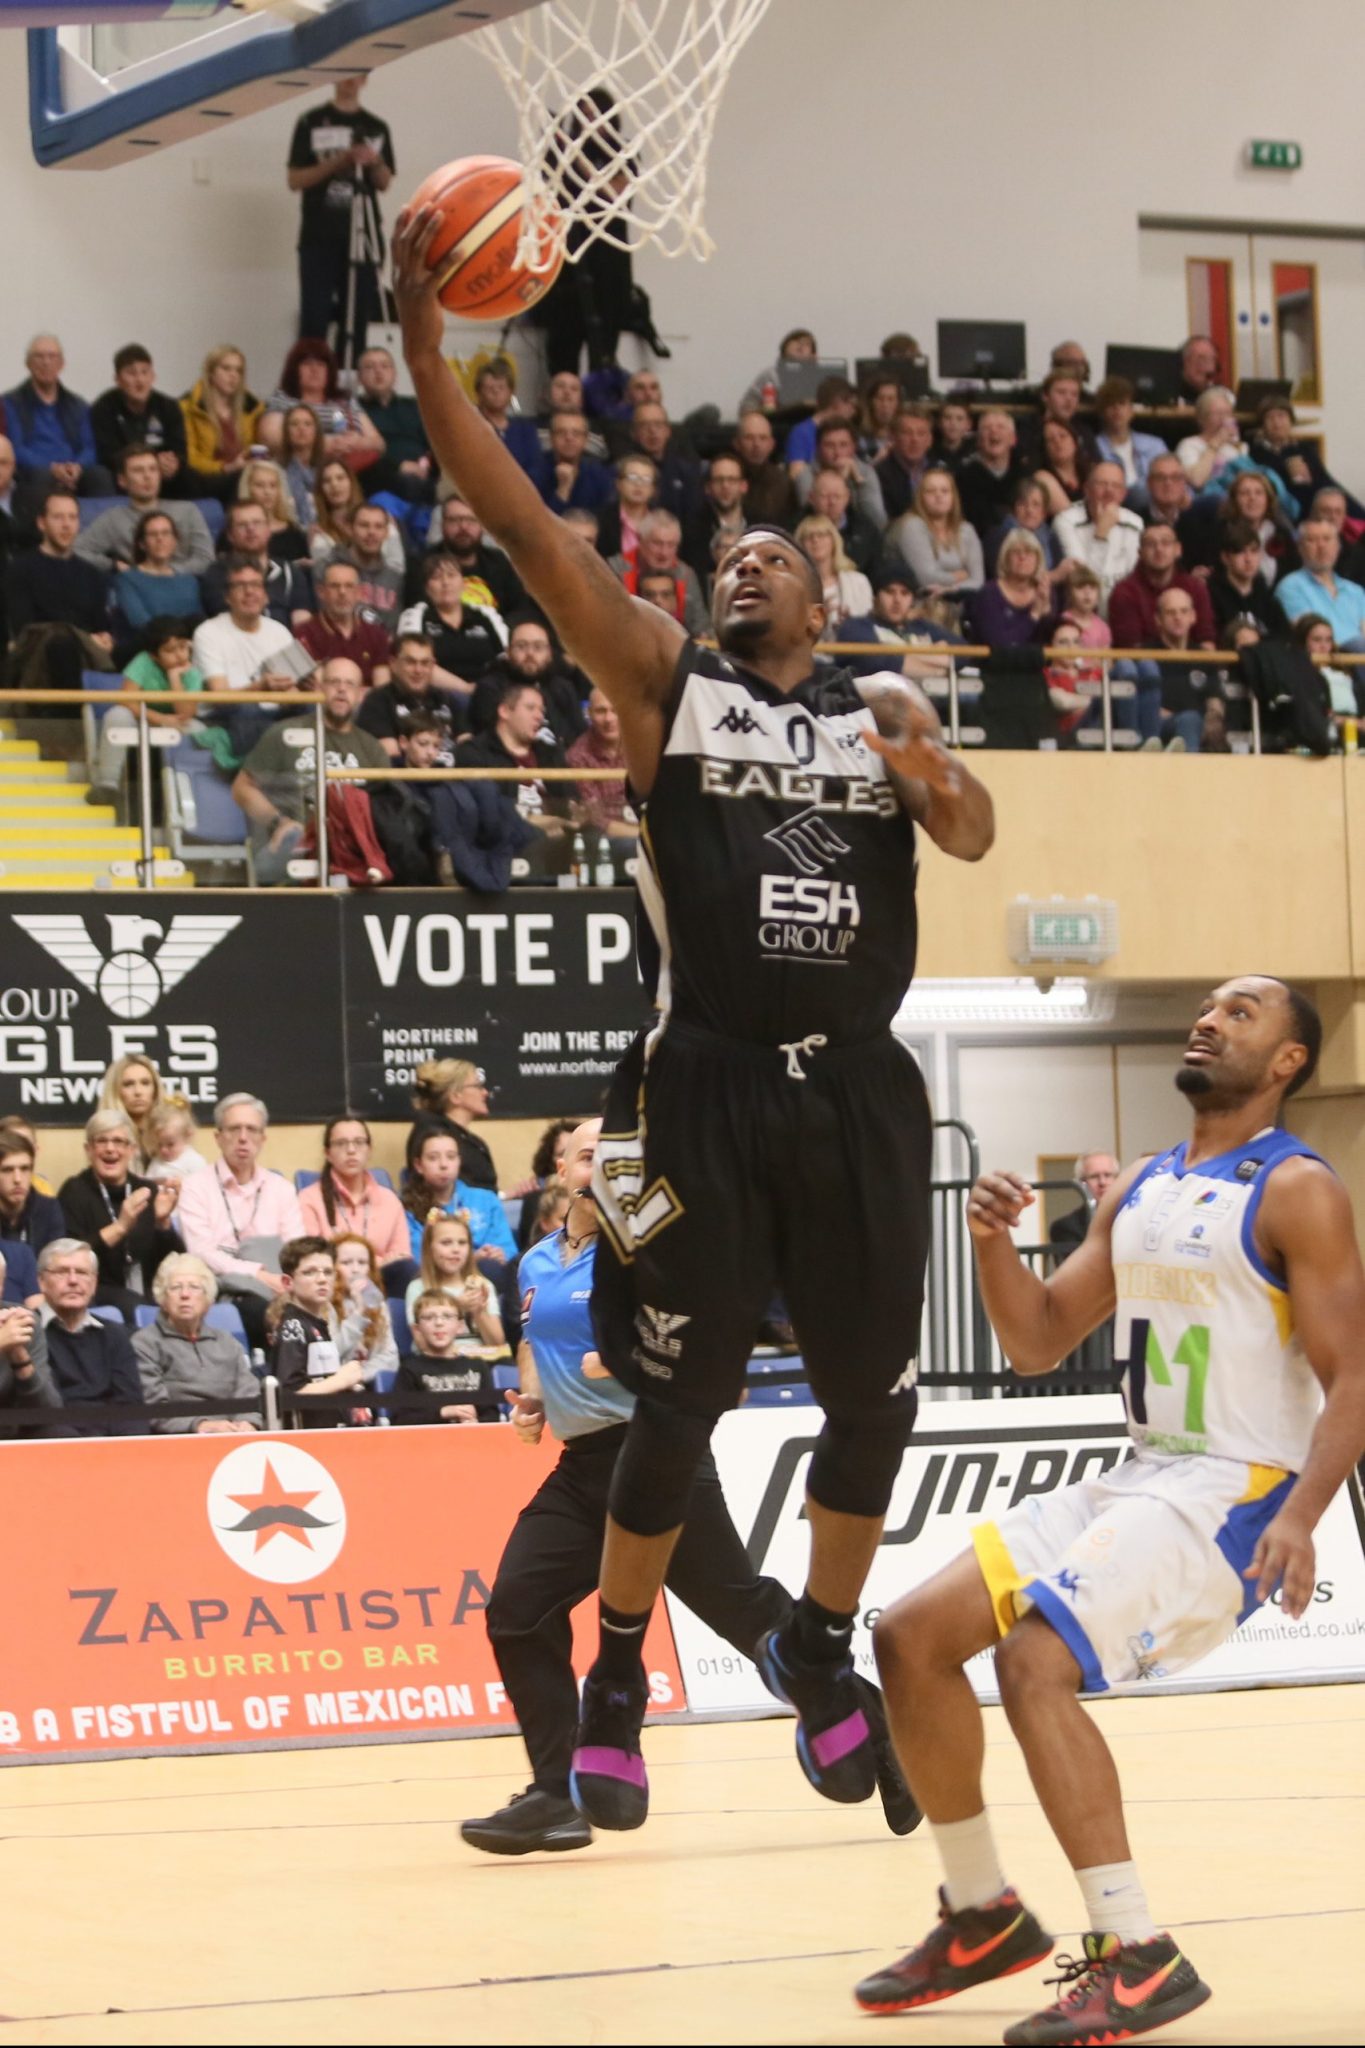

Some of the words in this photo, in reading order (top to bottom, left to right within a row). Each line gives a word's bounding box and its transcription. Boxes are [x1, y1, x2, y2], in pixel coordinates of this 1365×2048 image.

[787, 715, 816, 765] 0
[697, 756, 899, 818] EAGLES
[759, 873, 861, 926] ESH
[363, 913, 556, 987] VOTE
[586, 913, 645, 985] P
[758, 922, 856, 954] GROUP
[0, 987, 80, 1022] OUP
[382, 1028, 479, 1045] NORTHERN
[518, 1031, 562, 1052] JOIN
[565, 1030, 600, 1050] THE
[605, 1030, 639, 1050] REV
[383, 1048, 436, 1065] PRINT
[20, 1076, 218, 1105] NEWTLE
[68, 1569, 492, 1647] ZAPATISTA
[163, 1649, 344, 1680] BURRITO
[364, 1643, 439, 1669] BAR
[697, 1656, 744, 1676] 0191
[32, 1708, 60, 1742] A
[71, 1700, 232, 1740] FISTFUL
[243, 1695, 290, 1729] OF
[305, 1684, 474, 1726] MEXICAN
